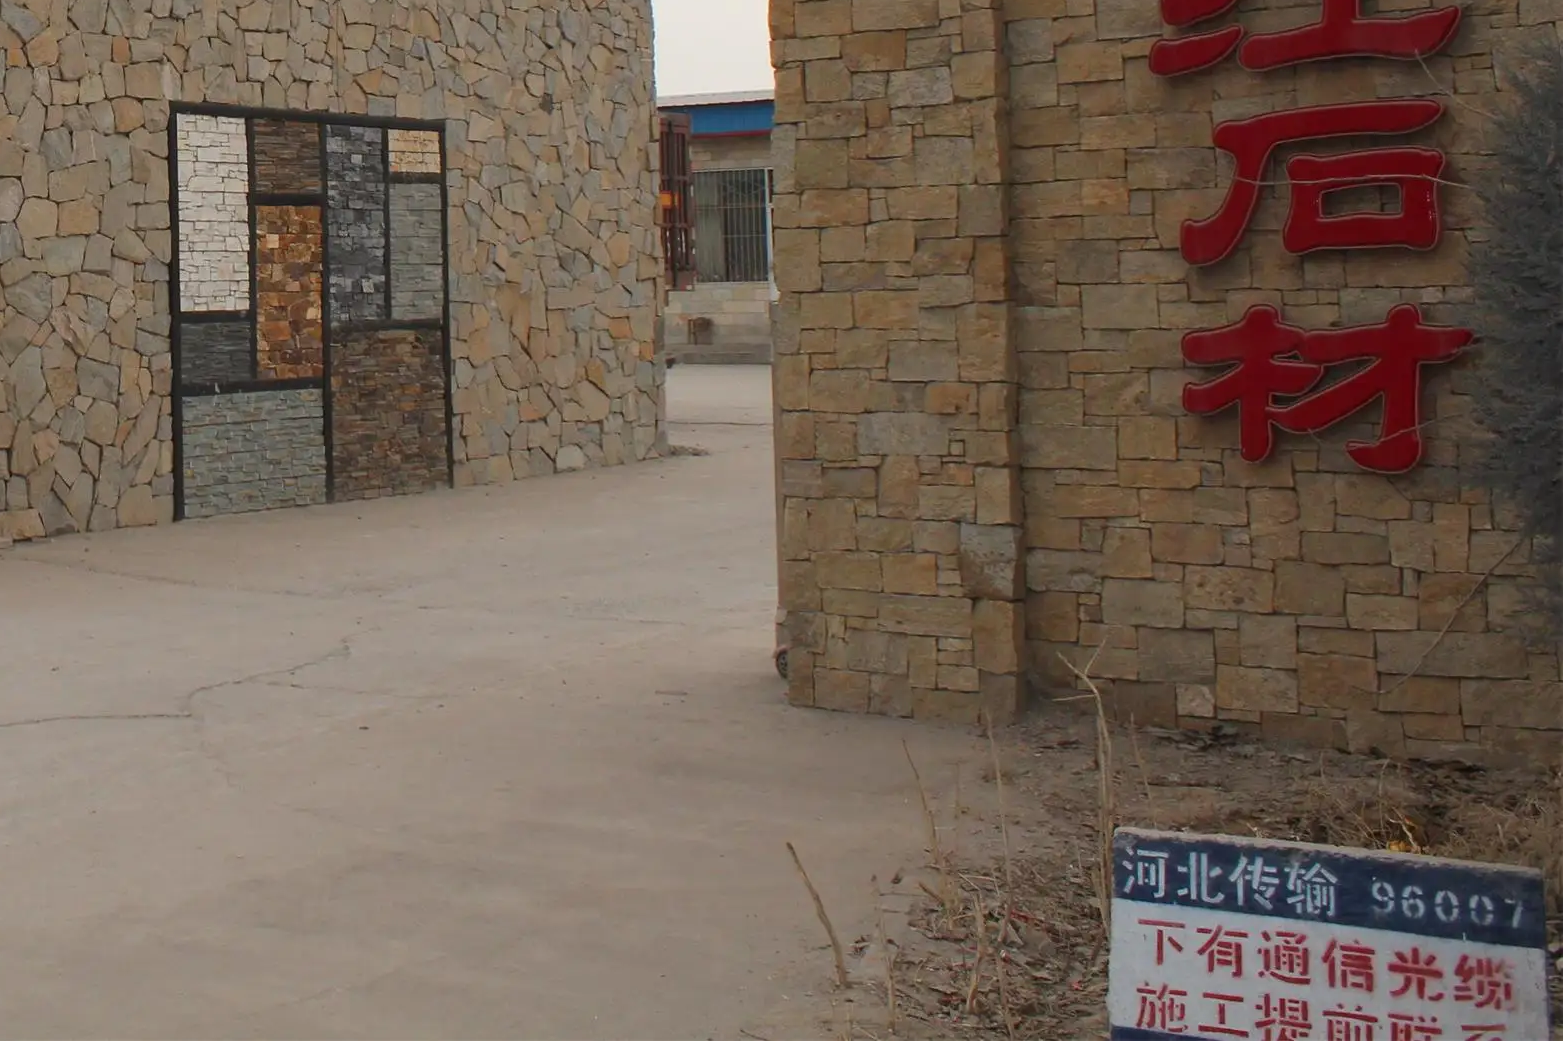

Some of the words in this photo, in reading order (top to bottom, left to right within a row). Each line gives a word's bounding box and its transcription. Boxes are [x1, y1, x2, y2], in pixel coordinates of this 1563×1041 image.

[1121, 847, 1338, 918] 河北传输
[1371, 880, 1525, 929] 96007
[1136, 918, 1518, 1012] 下有通信光缆
